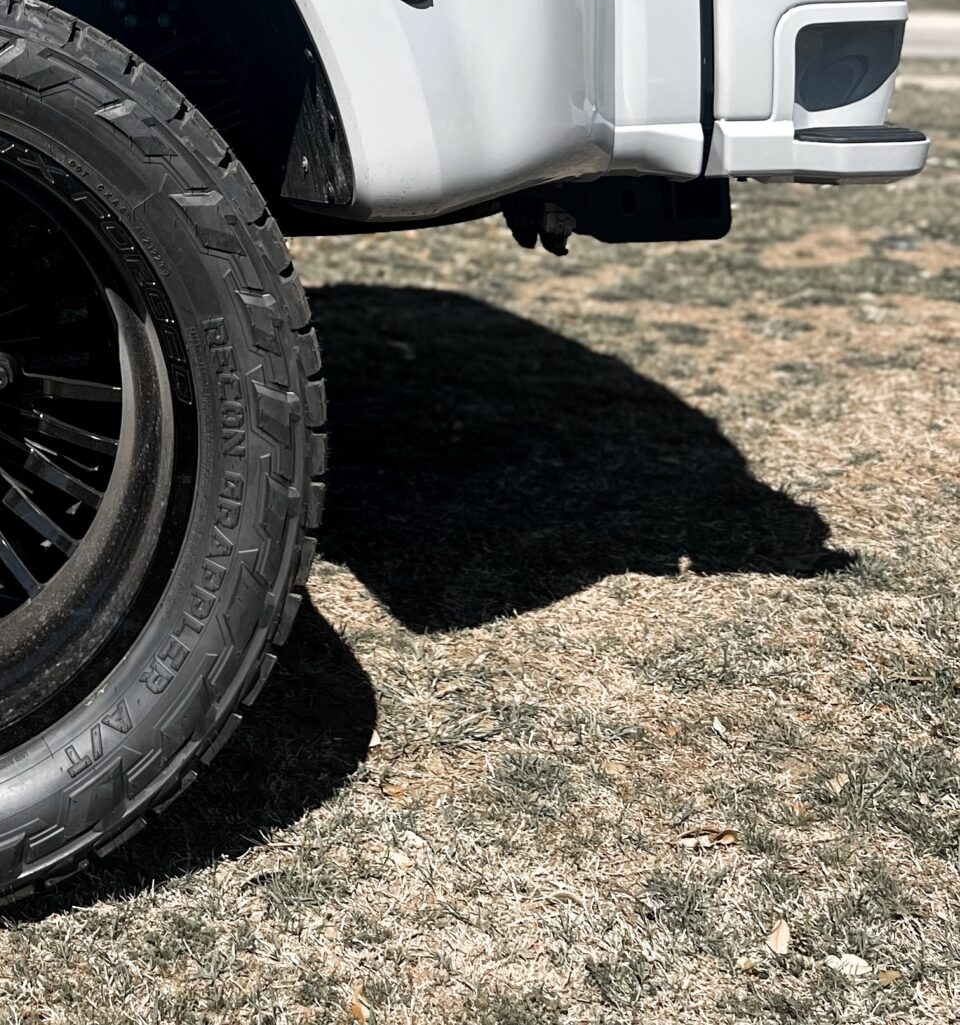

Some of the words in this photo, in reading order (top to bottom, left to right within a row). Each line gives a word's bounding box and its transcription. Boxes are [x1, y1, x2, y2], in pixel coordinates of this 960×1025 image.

[203, 316, 248, 461] RECON
[143, 478, 246, 696] GRAPPLER
[66, 698, 134, 779] A/T
